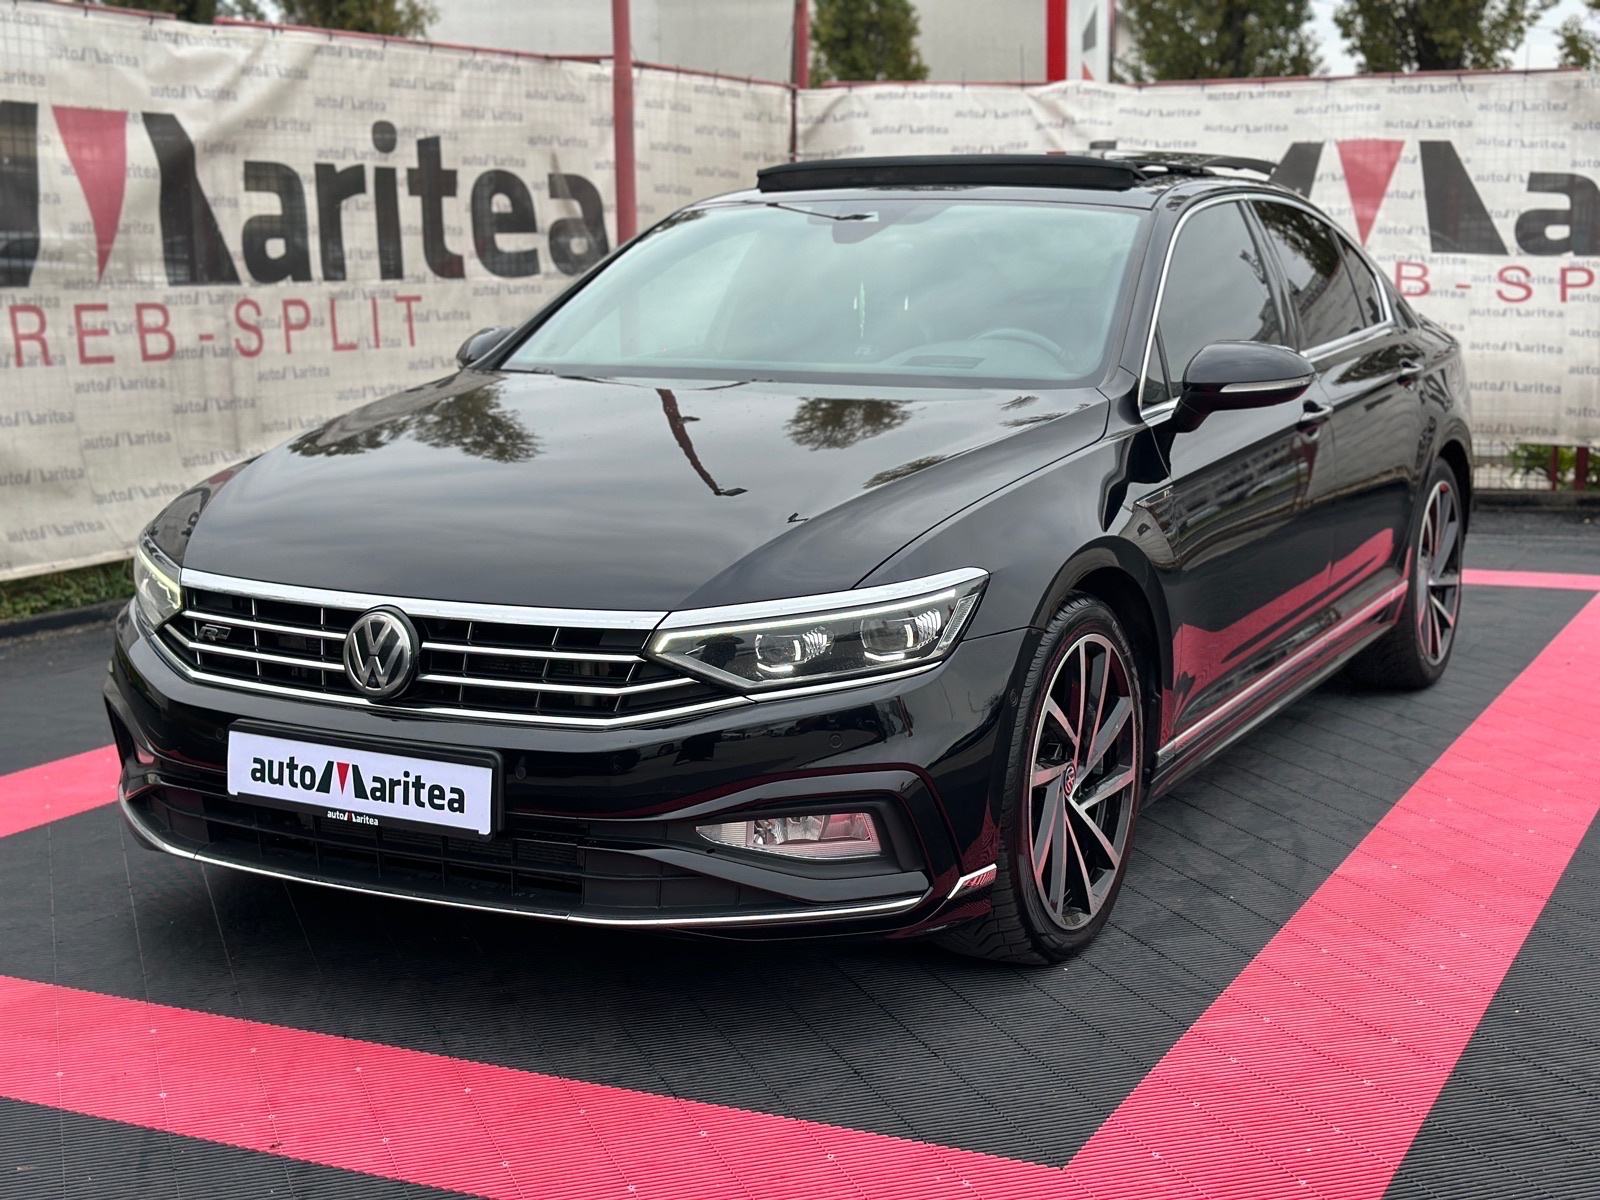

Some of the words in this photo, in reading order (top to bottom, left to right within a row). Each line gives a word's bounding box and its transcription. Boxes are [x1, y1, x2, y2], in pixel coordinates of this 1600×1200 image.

[1470, 307, 1565, 320] autoMaritea
[1470, 341, 1564, 355] autoMaritea
[250, 756, 465, 814] autoMaritea
[327, 809, 378, 826] autoMaritea
